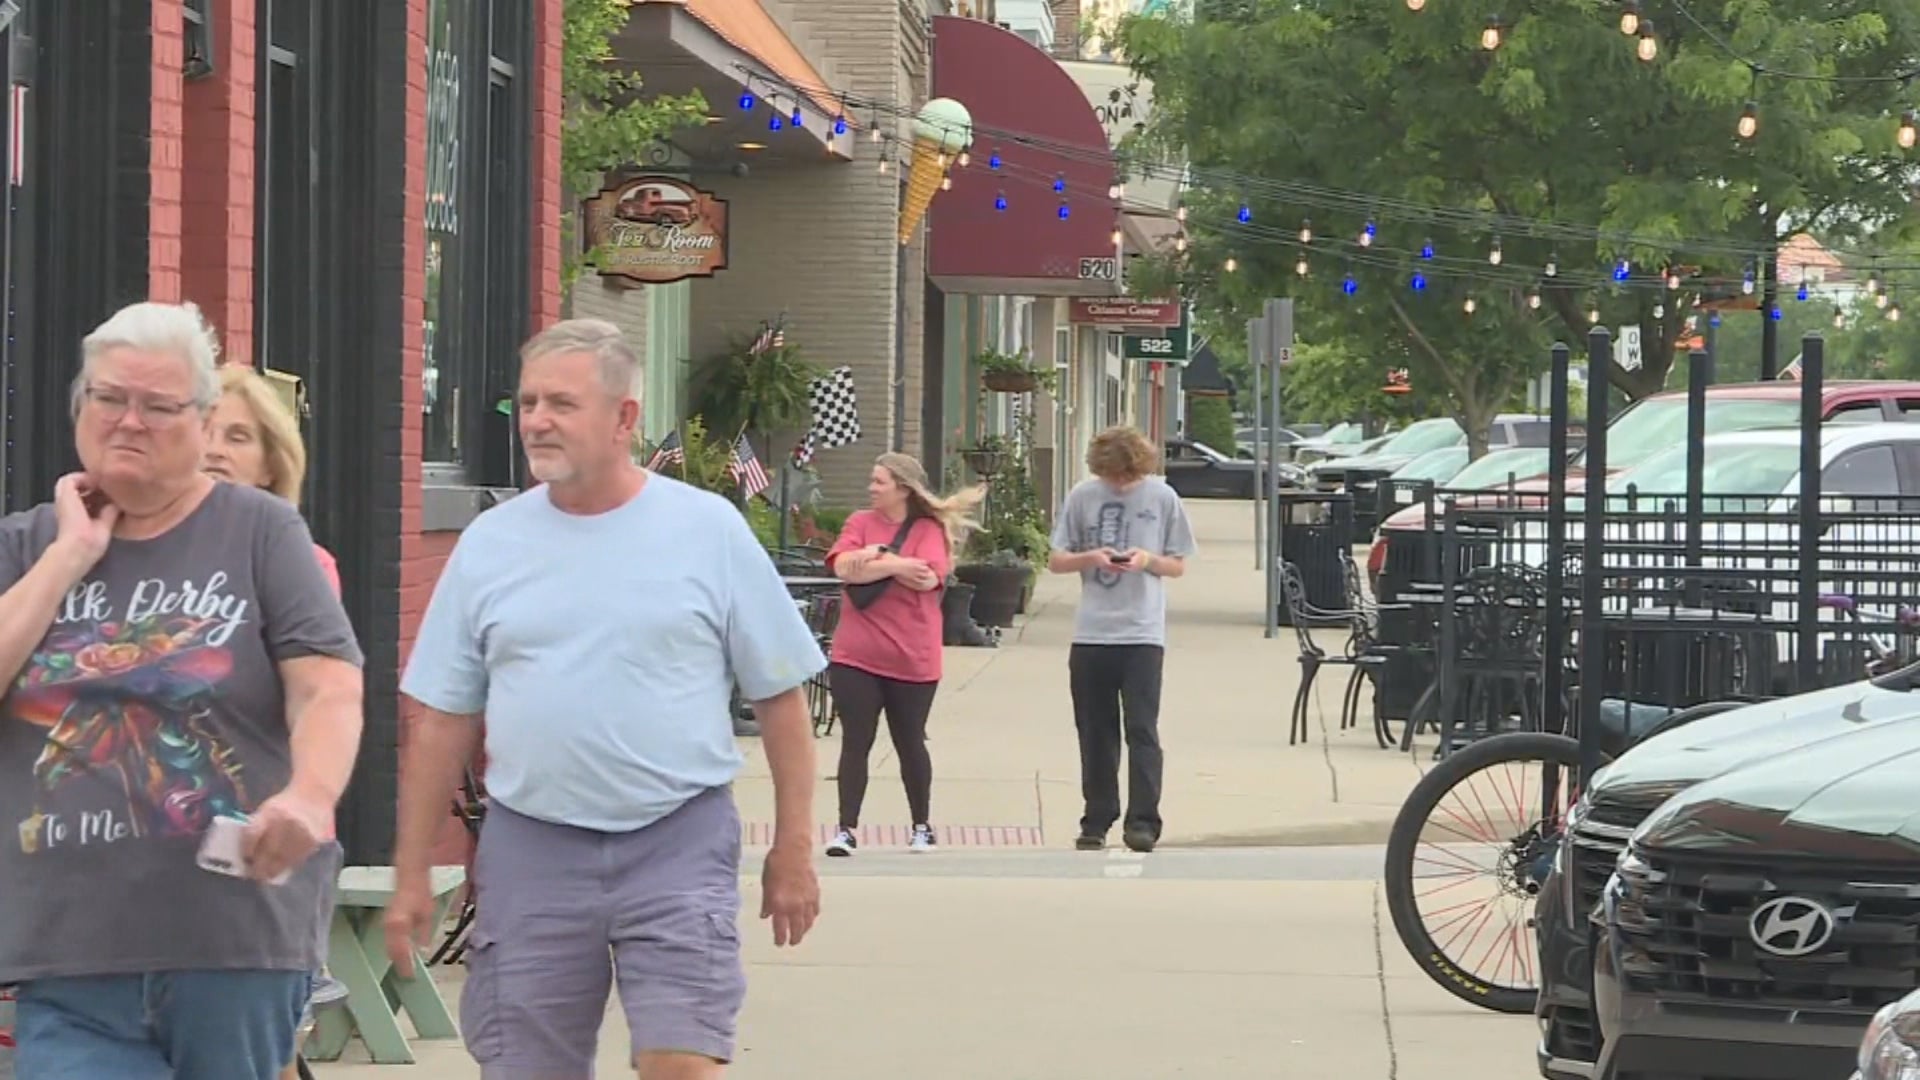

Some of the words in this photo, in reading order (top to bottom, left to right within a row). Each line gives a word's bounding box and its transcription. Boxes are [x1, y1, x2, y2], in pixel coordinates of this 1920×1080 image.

[609, 223, 648, 248] Tea
[657, 224, 715, 253] Room
[1079, 258, 1115, 280] 620
[1140, 338, 1173, 353] 522
[125, 570, 248, 647] Derby
[41, 813, 67, 848] To
[79, 808, 128, 846] Me
